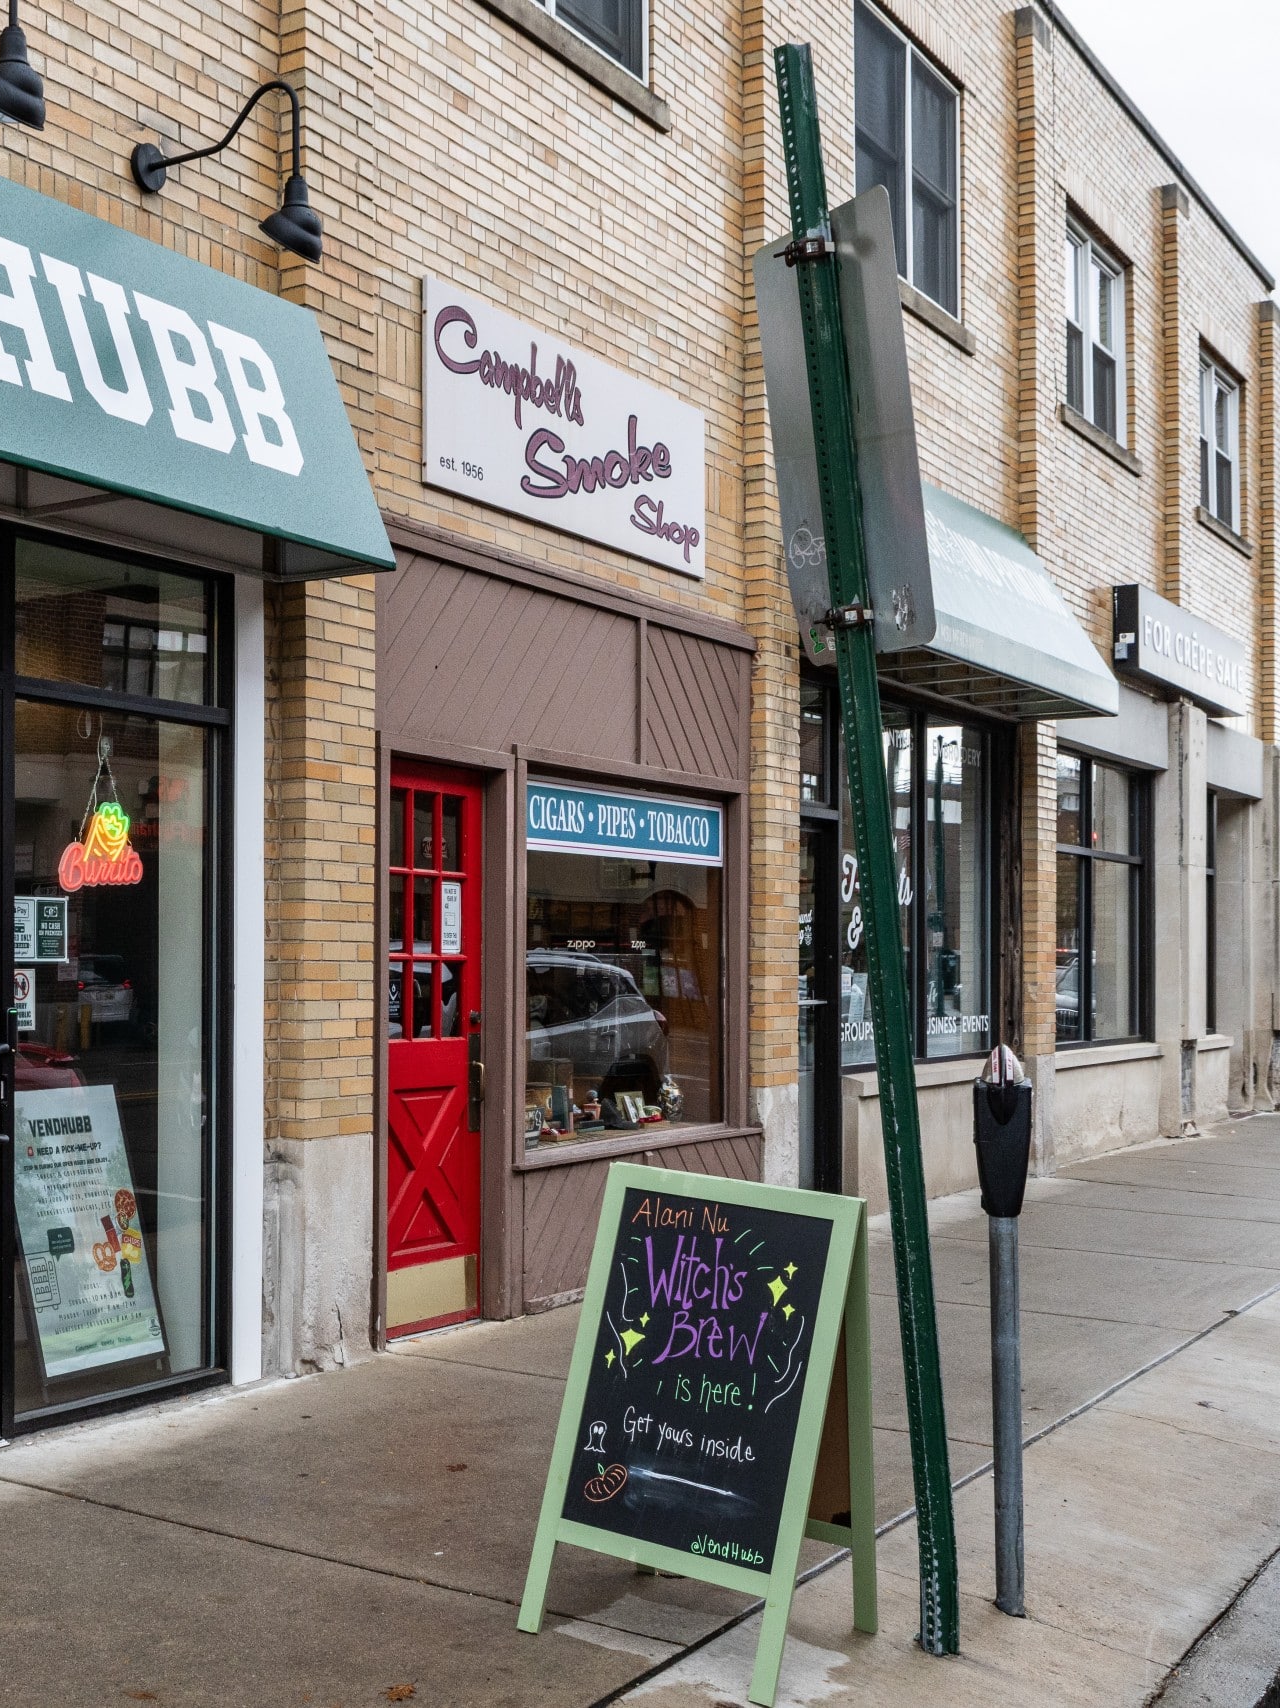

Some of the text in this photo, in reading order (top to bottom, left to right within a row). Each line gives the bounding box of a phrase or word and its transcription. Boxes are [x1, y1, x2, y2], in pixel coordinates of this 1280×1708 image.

[440, 456, 483, 481] est. 1956
[520, 413, 672, 498] Smoke
[630, 494, 700, 563] Shop
[1143, 615, 1245, 694] FOR CRÊPE SAKE
[530, 795, 710, 848] CIGARS PIPES TOBACCO
[61, 845, 142, 889] Burrito
[17, 906, 27, 915] Pay
[41, 922, 61, 930] NO CASH
[847, 905, 864, 950] &
[926, 1015, 989, 1035] USINESS EVENTS
[28, 1115, 92, 1138] VENDHUBB
[37, 1142, 102, 1156] NEED A PICK-ME-UP?
[632, 1197, 730, 1234] Alani Nu
[123, 1235, 141, 1248] CHIPS
[645, 1235, 748, 1309] Witch's
[675, 1374, 691, 1402] is
[623, 1406, 756, 1462] Get yours inside
